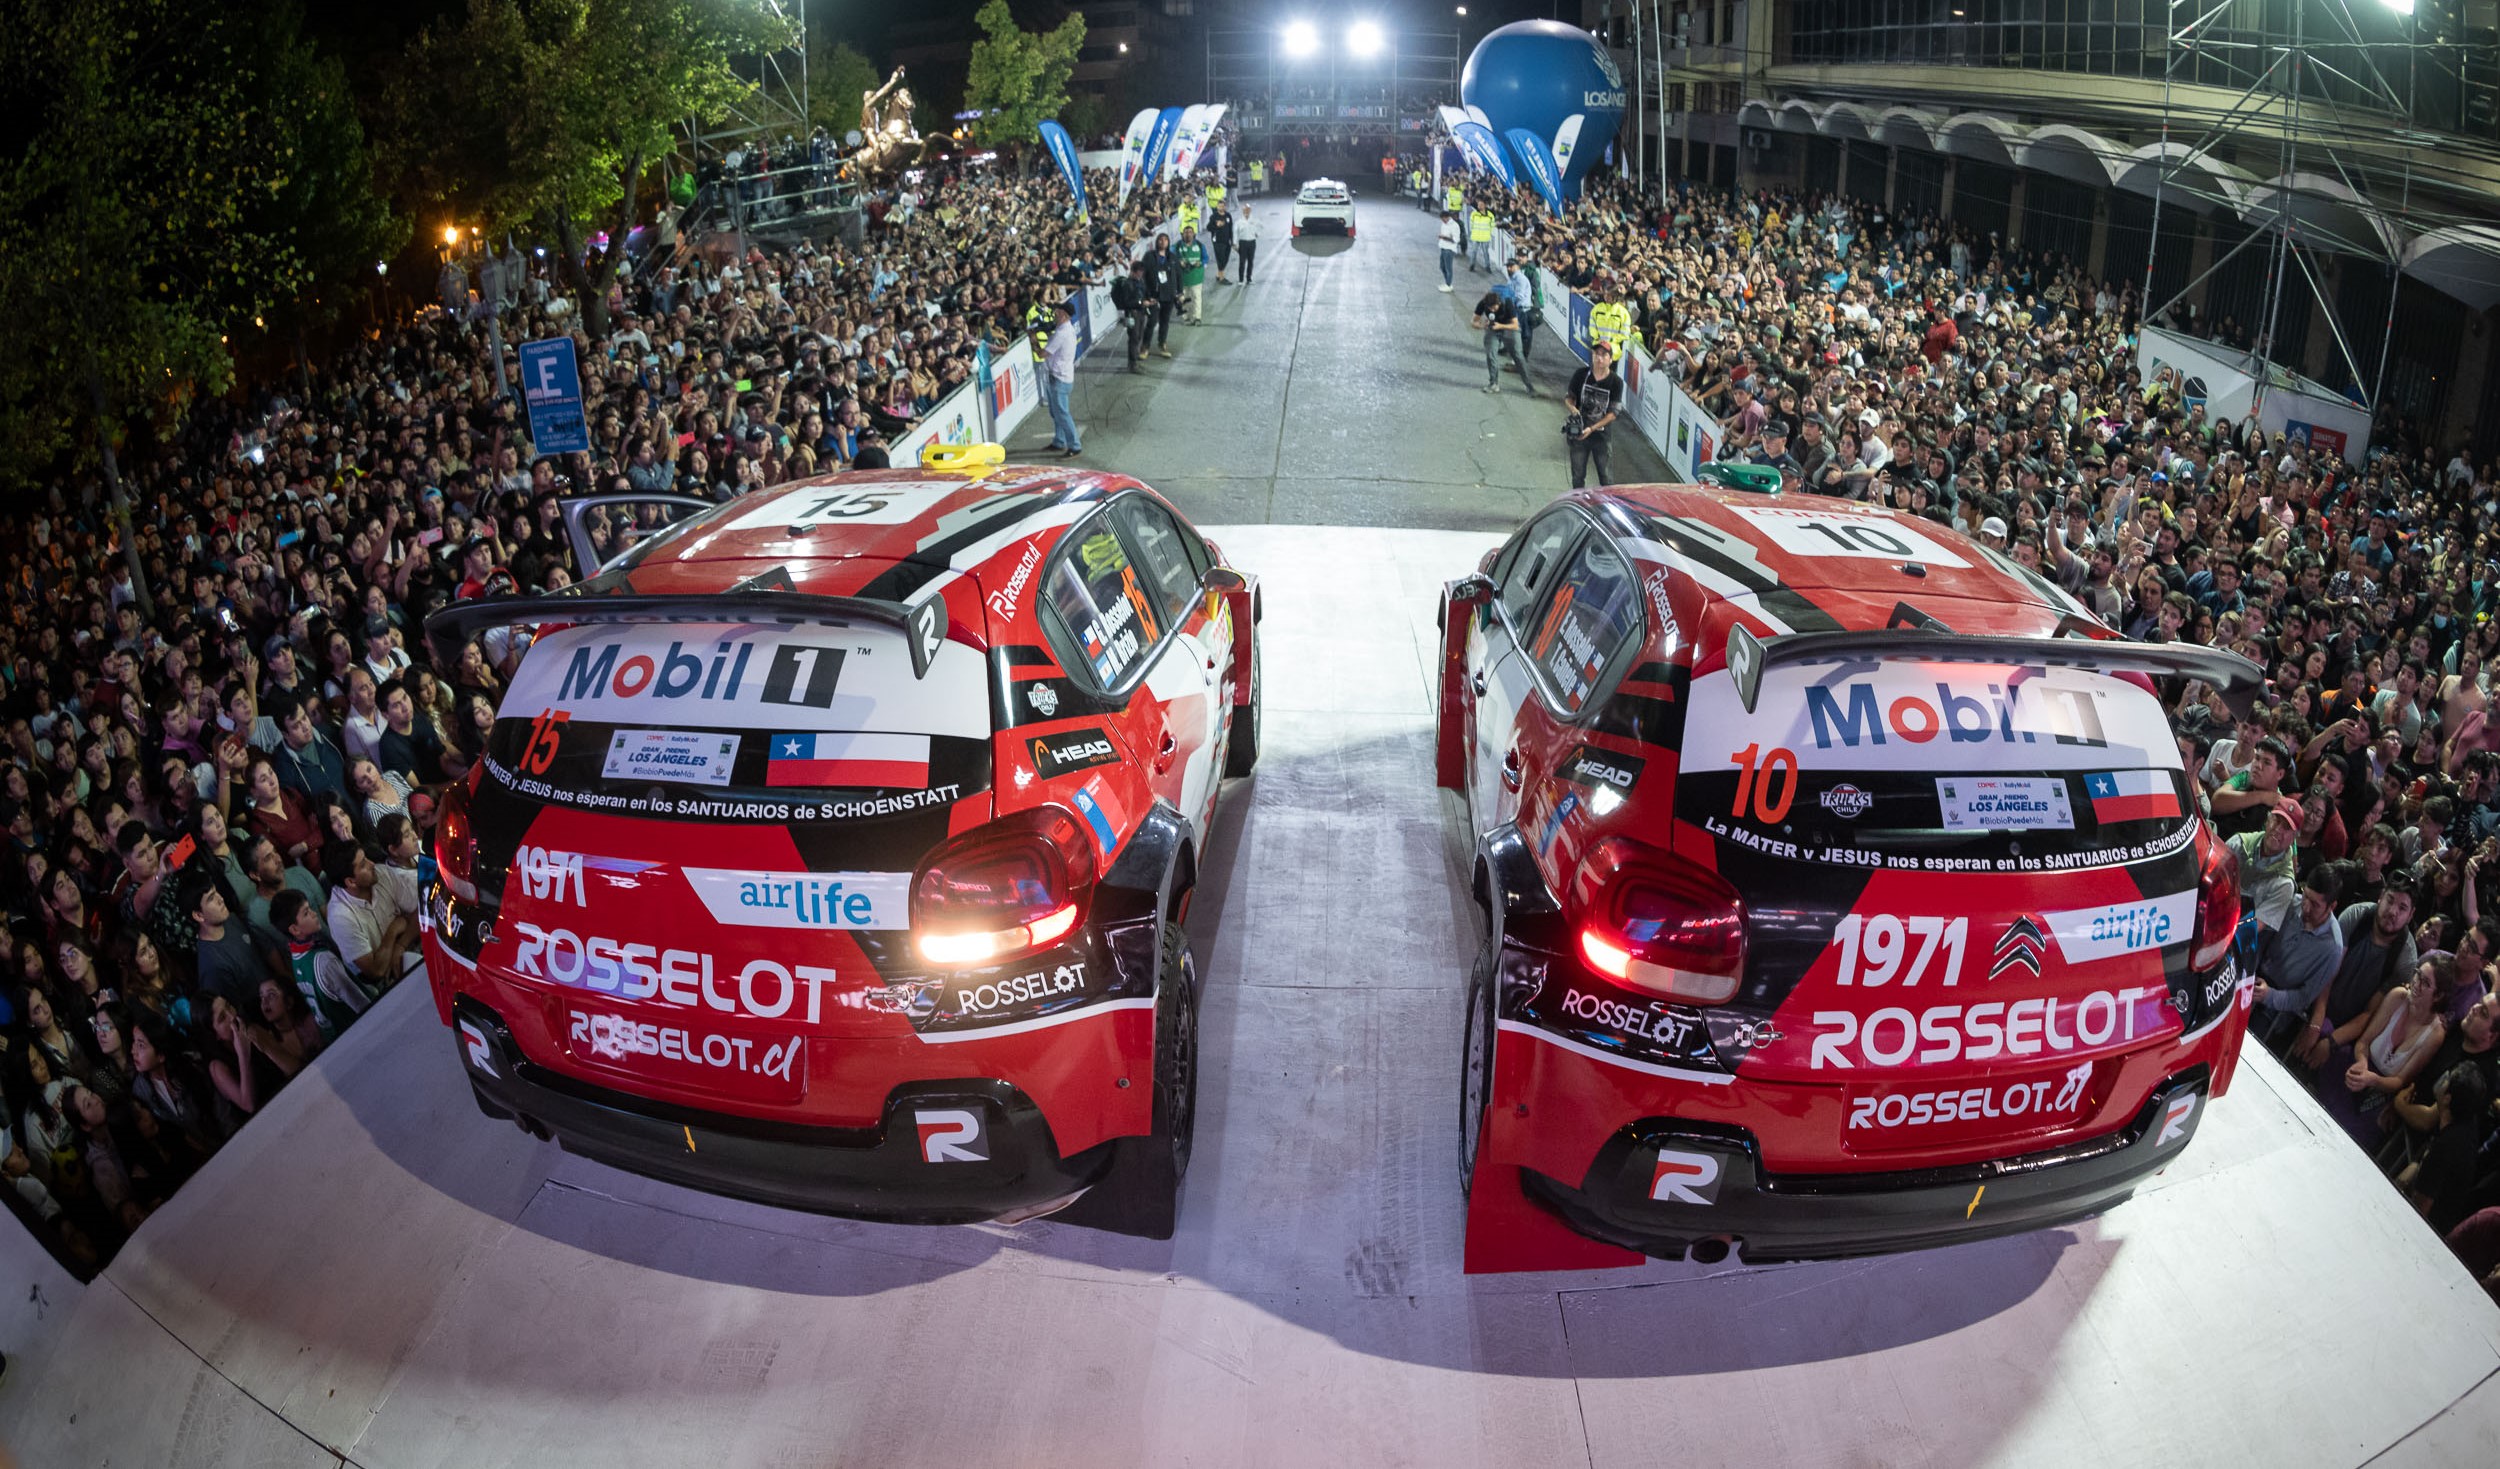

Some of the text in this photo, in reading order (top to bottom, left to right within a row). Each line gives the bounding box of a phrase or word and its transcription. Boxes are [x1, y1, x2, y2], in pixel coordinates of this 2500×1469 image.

[538, 357, 562, 397] E
[797, 492, 904, 518] 15
[1797, 522, 1914, 556] 10
[557, 641, 753, 701] Mobil
[520, 707, 571, 775] 15
[1805, 682, 2036, 750] Mobil
[628, 753, 651, 763] LOS
[1052, 741, 1113, 765] HEAD
[1574, 758, 1633, 787] HEAD
[484, 752, 959, 820] La MATER y JESUS nos esperan en los SANTUARIOS de SCHOENSTATT
[1730, 743, 1798, 824] 10
[1821, 792, 1871, 808] TRUCKS
[1968, 802, 1992, 812] LOS
[1705, 816, 1727, 836] La
[1731, 827, 1798, 859] MATER
[1819, 848, 1882, 867] JESUS
[1887, 855, 1919, 869] nos
[1924, 857, 1991, 873] esperan
[1997, 859, 2015, 871] en
[2020, 856, 2041, 870] los
[2045, 846, 2129, 869] SANTUARIOS
[2131, 845, 2144, 858] de
[2146, 813, 2196, 857] SCHOENSTATT
[516, 844, 587, 907] 1971
[740, 873, 872, 926] airlife
[1832, 914, 1968, 987] 1971
[2091, 906, 2170, 948] airlife
[516, 922, 836, 1024] ROSSELOT
[958, 963, 1087, 1014] ROSSELOT
[570, 1010, 801, 1082] ROSSELOT.cl
[1562, 988, 1693, 1049] ROSSELOT
[1811, 987, 2144, 1070] ROSSELOT
[1849, 1061, 2093, 1130] ROSSELOT.cl
[915, 1110, 991, 1163] R
[1652, 1149, 1719, 1205] R
